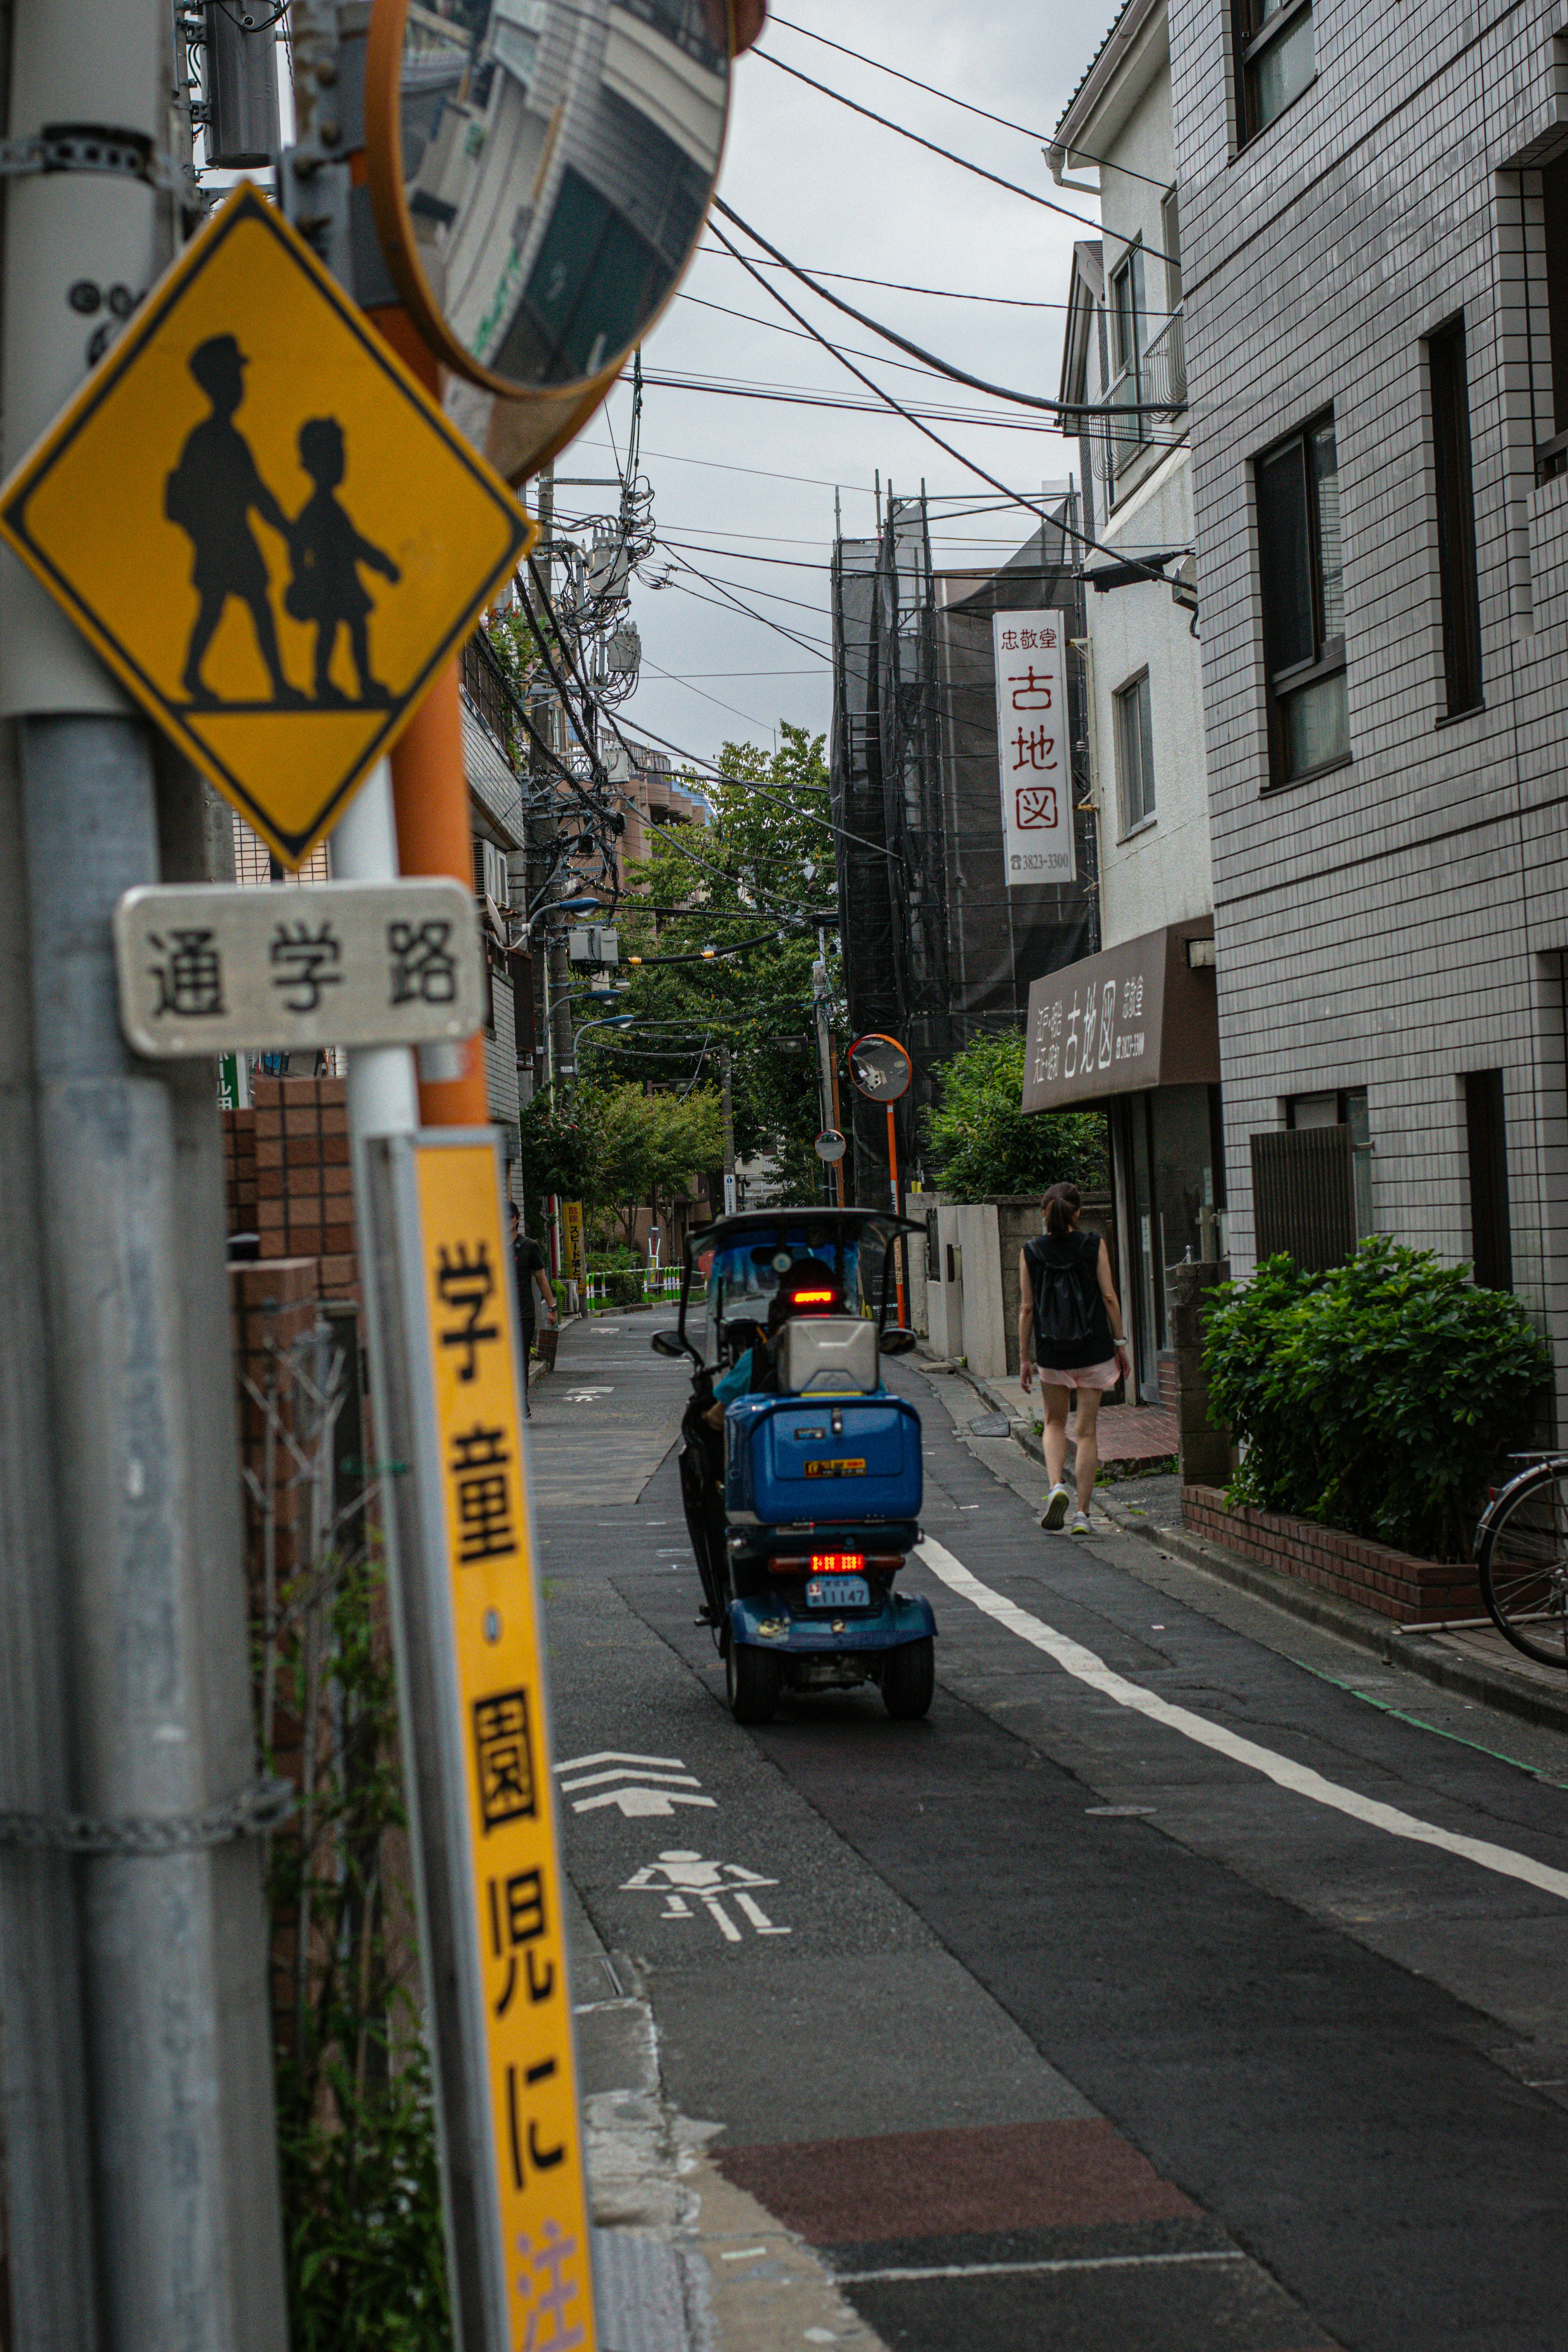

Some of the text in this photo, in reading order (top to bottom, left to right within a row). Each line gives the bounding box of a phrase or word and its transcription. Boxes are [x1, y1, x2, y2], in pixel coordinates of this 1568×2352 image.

[1001, 628, 1057, 650] 忠敬堂
[1008, 665, 1058, 830] 古地図
[1022, 853, 1069, 870] 3823-3300
[150, 921, 457, 1017] 通学路
[1064, 980, 1116, 1079] 古地図
